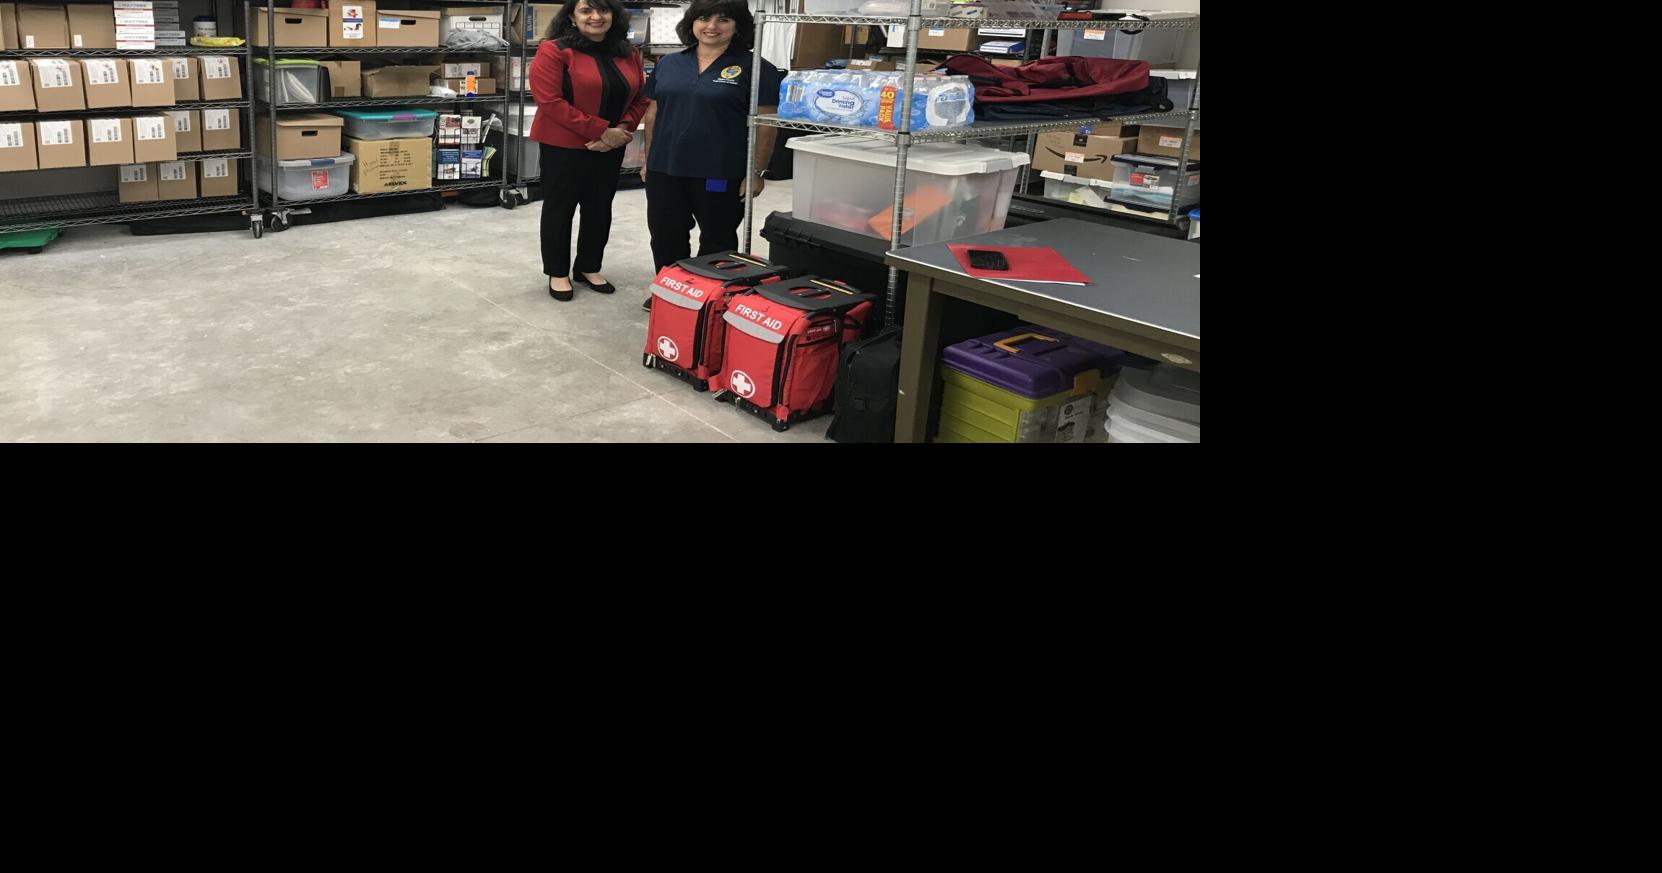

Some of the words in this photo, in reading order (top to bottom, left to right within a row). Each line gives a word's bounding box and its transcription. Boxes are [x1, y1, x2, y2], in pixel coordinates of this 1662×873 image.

[880, 90, 895, 99] 40
[884, 105, 893, 123] VALUE
[660, 276, 688, 292] FIRST
[686, 287, 704, 298] AID
[735, 304, 765, 322] FIRST
[763, 317, 782, 330] AID
